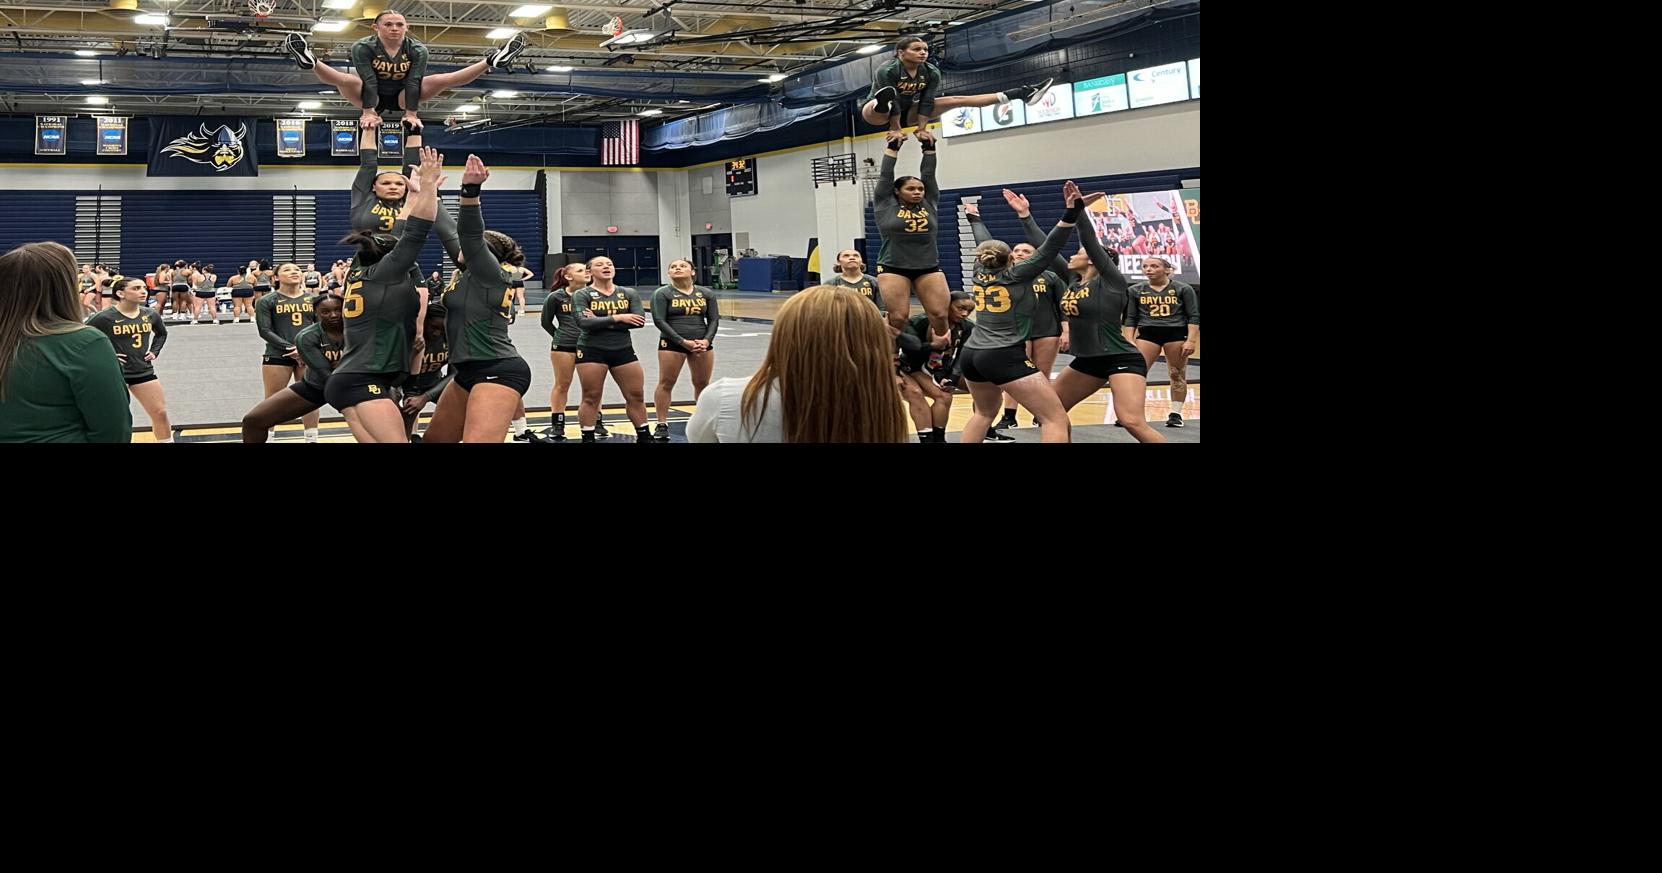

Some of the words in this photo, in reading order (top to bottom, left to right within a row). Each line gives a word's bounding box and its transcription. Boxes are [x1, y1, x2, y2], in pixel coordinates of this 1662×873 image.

[1151, 67, 1182, 78] Century
[904, 218, 929, 233] 32
[590, 300, 629, 311] BAYLOR
[671, 298, 707, 308] BAYLOR
[972, 285, 1011, 313] 33
[1140, 296, 1178, 305] BAYLOR
[276, 303, 314, 314] BAYLOR
[1061, 299, 1080, 316] 36
[1149, 304, 1171, 317] 20
[291, 312, 303, 326] 9
[112, 322, 153, 335] BAYLOR
[131, 333, 143, 349] 3
